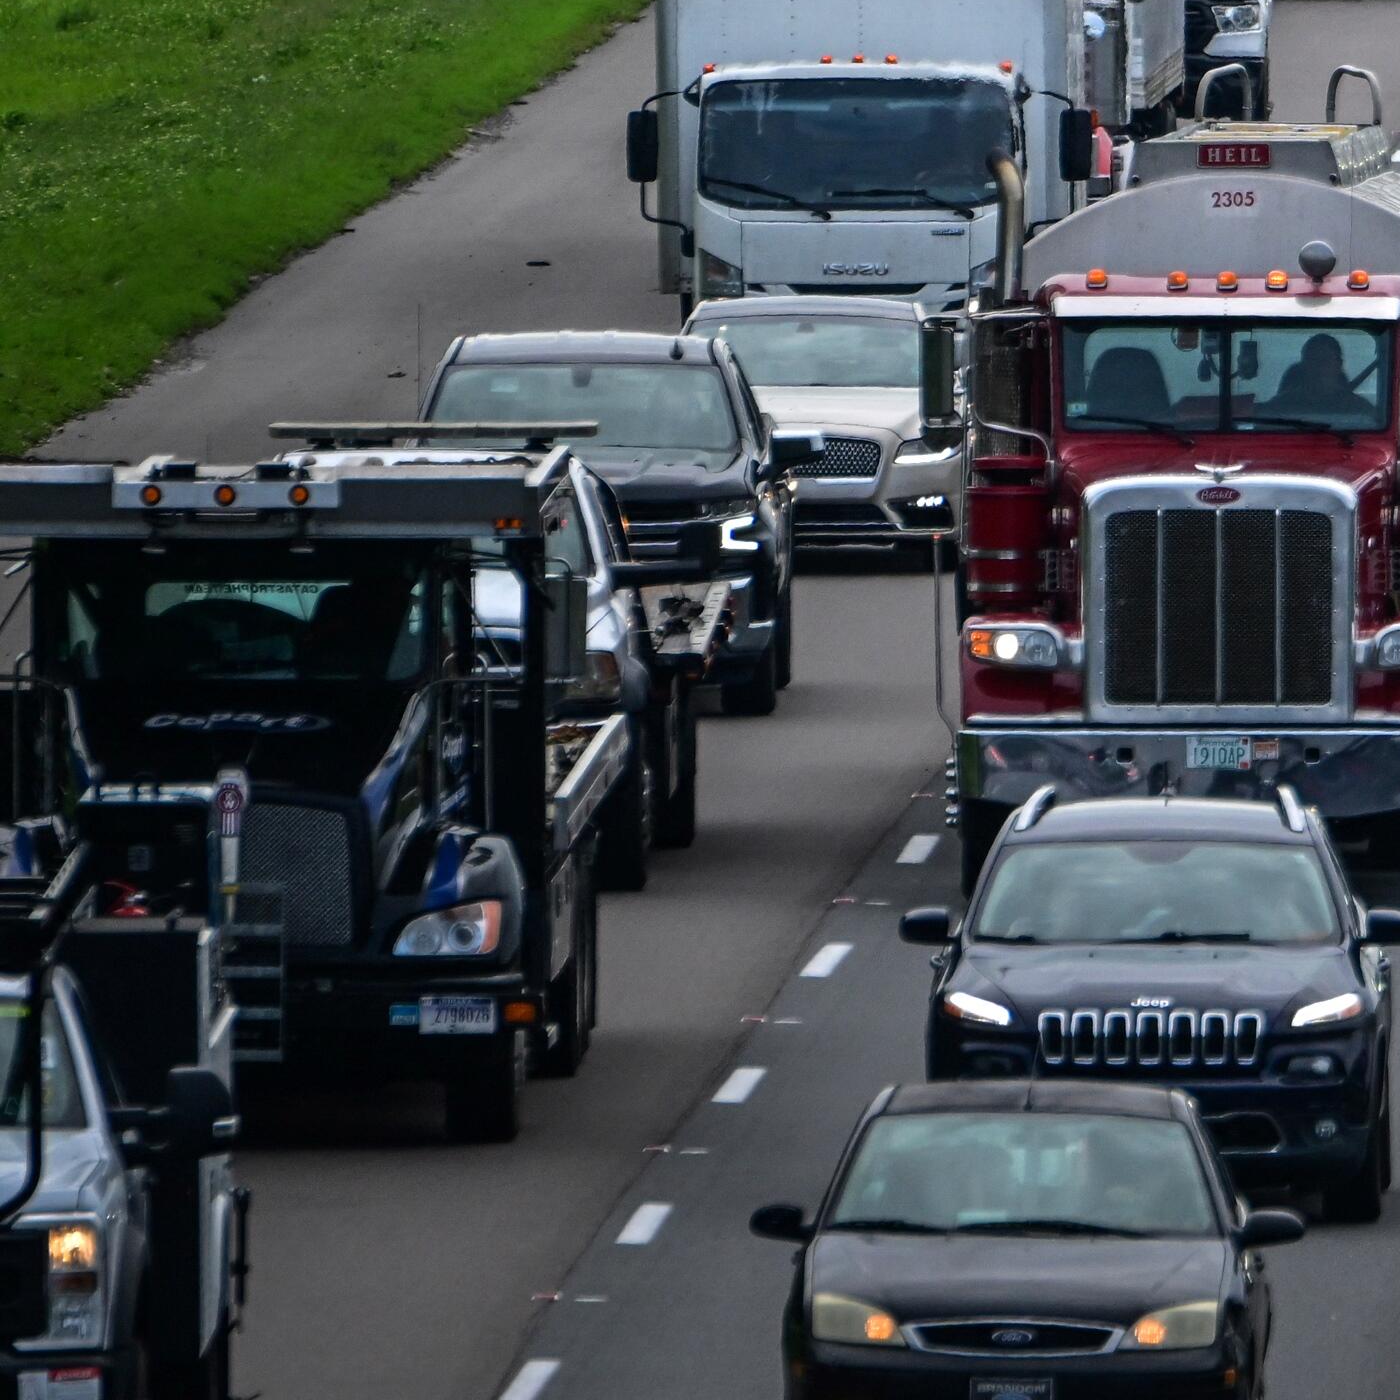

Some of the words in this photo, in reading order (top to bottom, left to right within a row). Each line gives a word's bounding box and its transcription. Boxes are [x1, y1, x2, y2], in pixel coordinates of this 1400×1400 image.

[1207, 147, 1261, 163] HEIL
[1210, 191, 1255, 209] 2305
[822, 262, 889, 277] ISUZU
[1130, 997, 1170, 1009] Jeep
